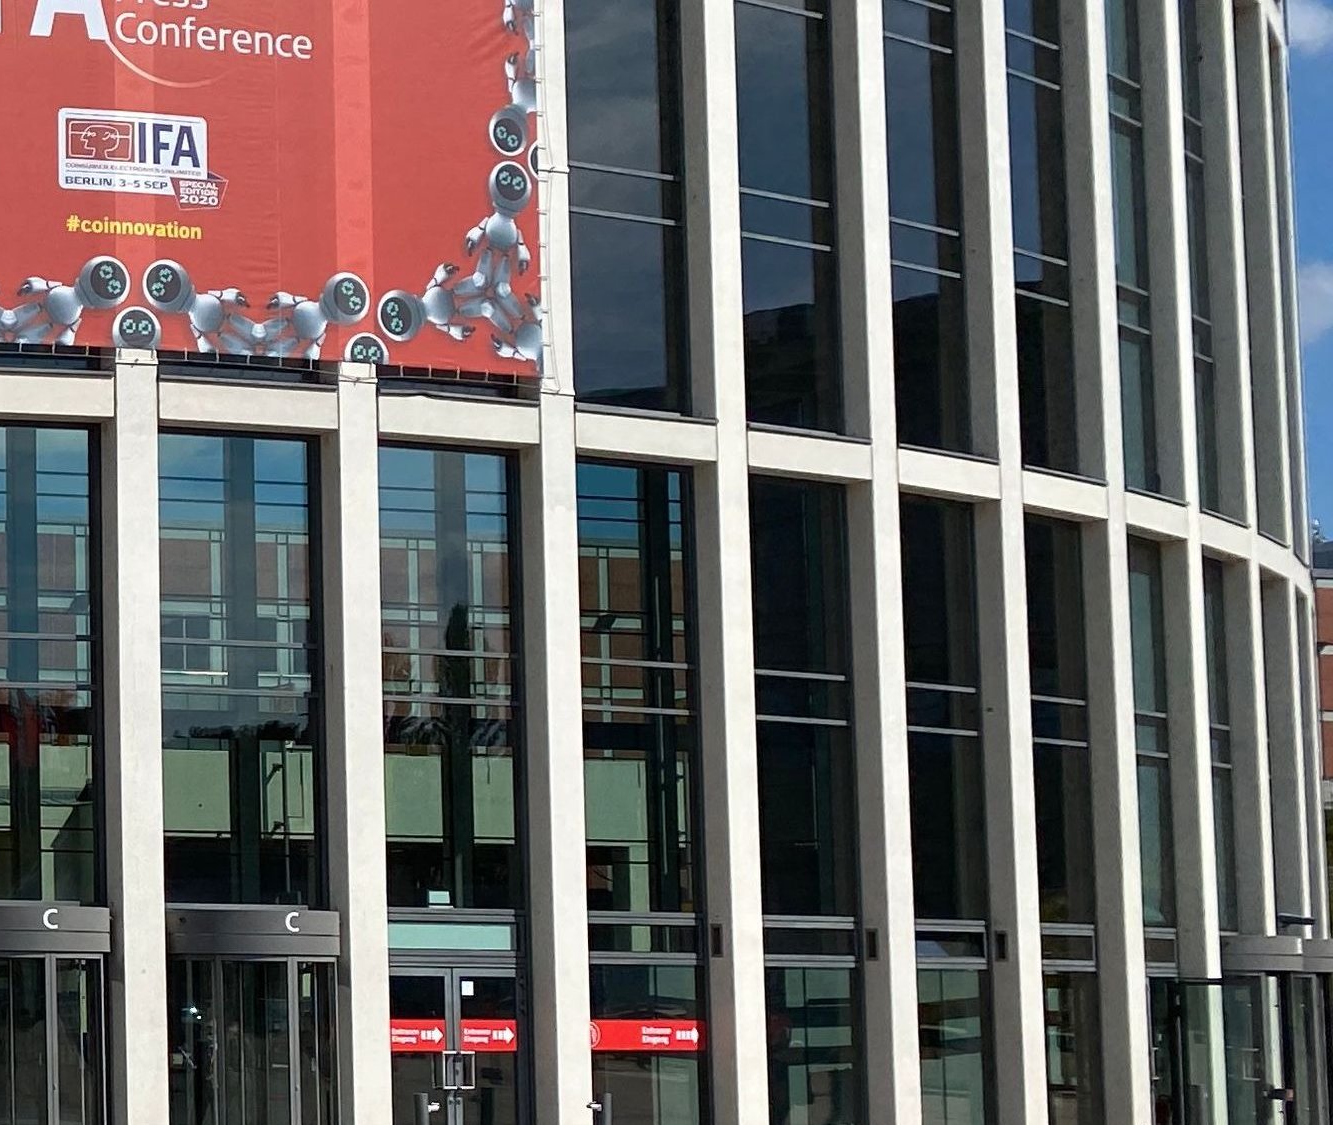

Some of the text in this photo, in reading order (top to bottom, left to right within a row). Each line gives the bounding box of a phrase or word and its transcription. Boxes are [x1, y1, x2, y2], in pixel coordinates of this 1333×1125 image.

[115, 12, 314, 60] Conference
[138, 122, 201, 168] IFA
[144, 180, 168, 190] SEP
[179, 180, 219, 190] SPECIAL
[179, 187, 219, 197] EDITION
[179, 194, 219, 206] 2020
[66, 215, 202, 240] #coinnovation
[43, 908, 59, 930] C
[285, 911, 300, 933] C
